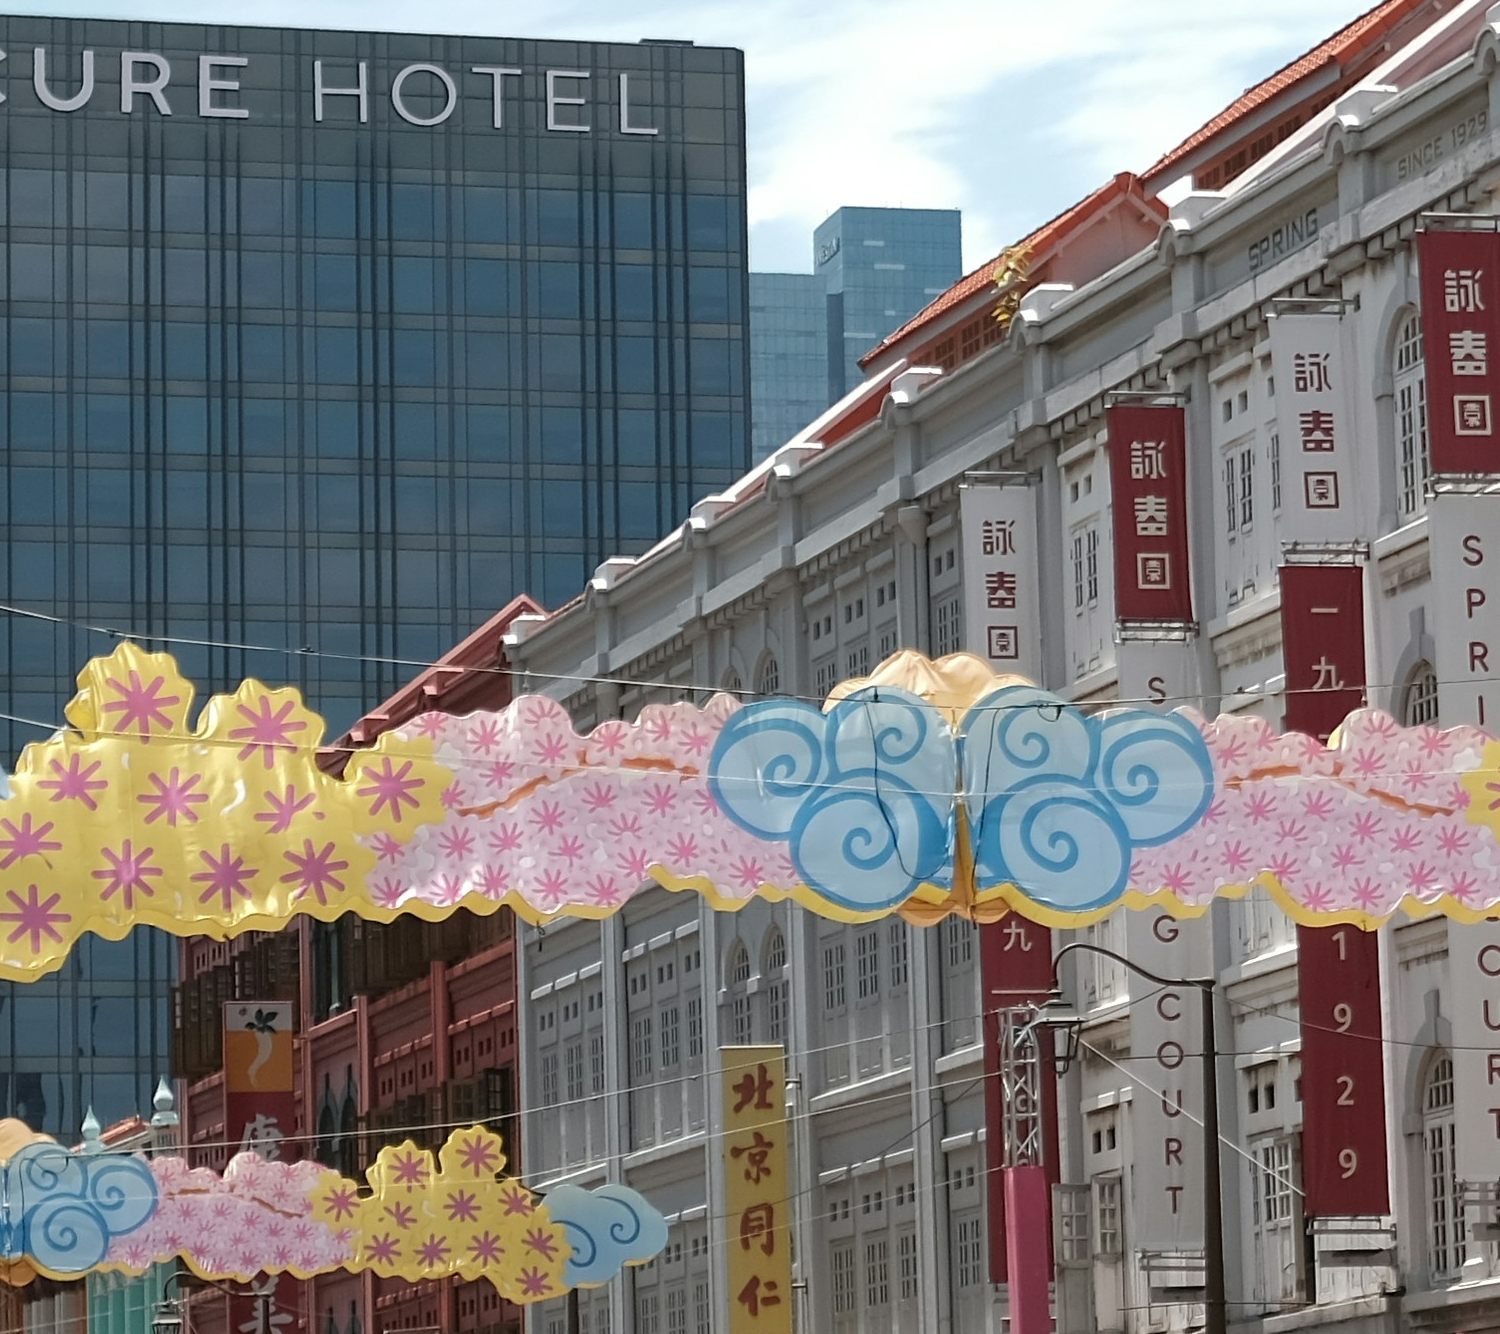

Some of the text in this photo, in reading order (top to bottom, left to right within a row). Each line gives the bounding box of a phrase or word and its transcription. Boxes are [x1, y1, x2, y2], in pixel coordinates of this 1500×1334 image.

[313, 59, 661, 137] HOTEL
[1397, 110, 1487, 180] SINCE 1929
[1248, 207, 1319, 268] SPRING
[1330, 931, 1358, 1179] 1929
[1155, 992, 1185, 1217] COURT
